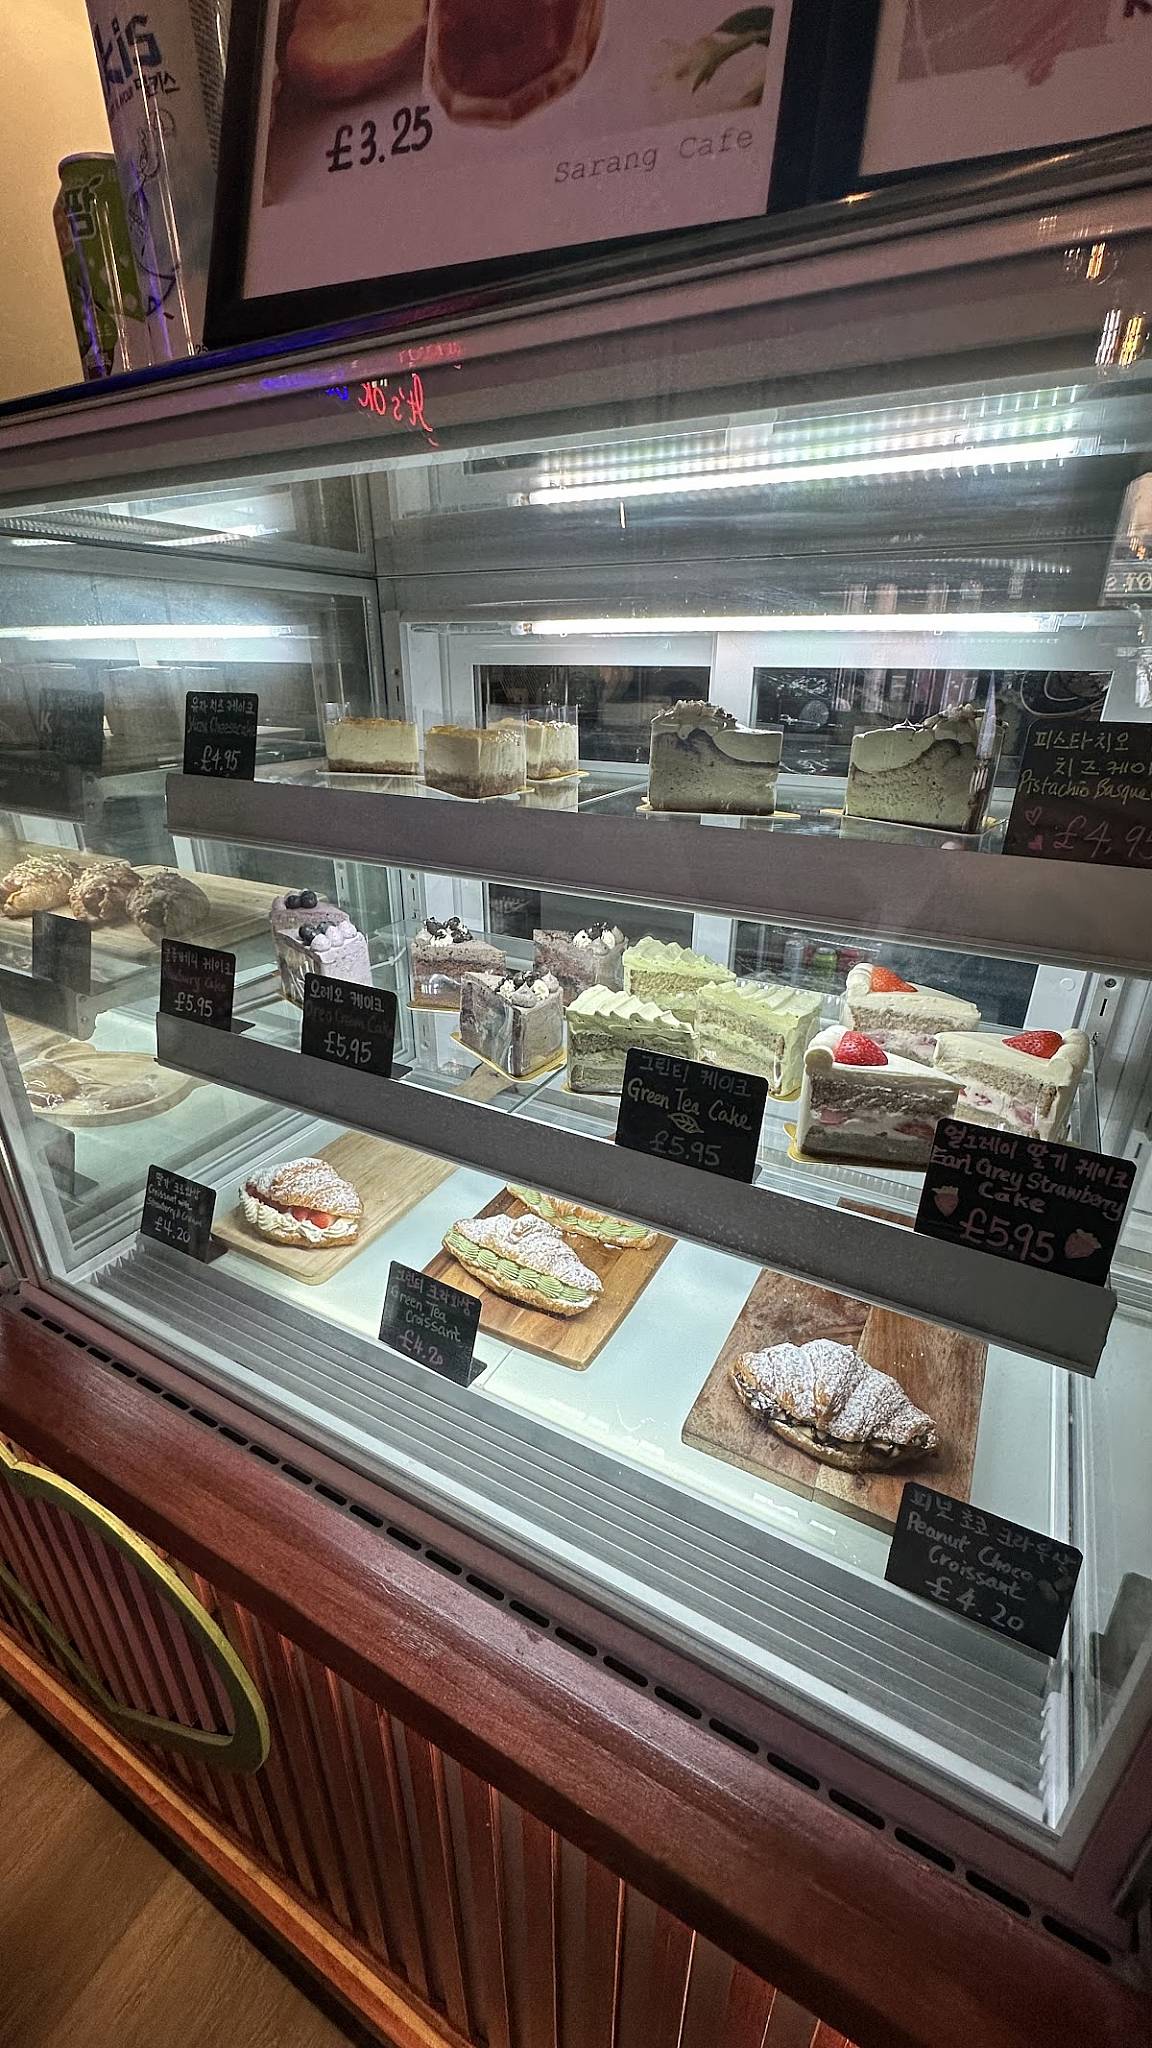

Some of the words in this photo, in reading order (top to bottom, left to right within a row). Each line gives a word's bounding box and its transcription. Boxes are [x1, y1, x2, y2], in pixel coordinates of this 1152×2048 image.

[325, 105, 433, 172] £3.25
[555, 145, 657, 183] Sarang
[679, 127, 754, 160] Cafe
[200, 745, 241, 772] £4.95
[1033, 730, 1129, 753] 피스타치오
[1054, 757, 1100, 777] 치즈
[1018, 769, 1089, 798] Pistachio
[1094, 777, 1151, 805] Basque
[203, 957, 234, 976] 케이크
[174, 992, 213, 1018] £5.95
[310, 980, 344, 1003] 오레오
[350, 991, 385, 1013] 케이크
[640, 1054, 690, 1083] 그린티
[701, 1070, 752, 1097] 케이크
[627, 1077, 670, 1110] Green
[675, 1087, 700, 1116] Tea
[708, 1099, 752, 1131] Cake
[649, 1130, 722, 1166] £5.95
[945, 1124, 1018, 1160] 얼그레이
[1027, 1142, 1068, 1172] 딸기
[1075, 1157, 1129, 1189] 케이크
[930, 1145, 972, 1175] Earl
[976, 1158, 1024, 1192] Grey
[978, 1181, 1046, 1214] Cake
[155, 1216, 191, 1243] £4.20
[959, 1207, 1056, 1264] £5.95
[391, 1284, 422, 1311] Green
[427, 1301, 447, 1323] Tea
[399, 1329, 443, 1365] £4.20
[959, 1509, 990, 1538] 초코
[907, 1511, 971, 1553] Peanut
[978, 1546, 1033, 1581] Choco
[928, 1545, 1027, 1601] Croissant
